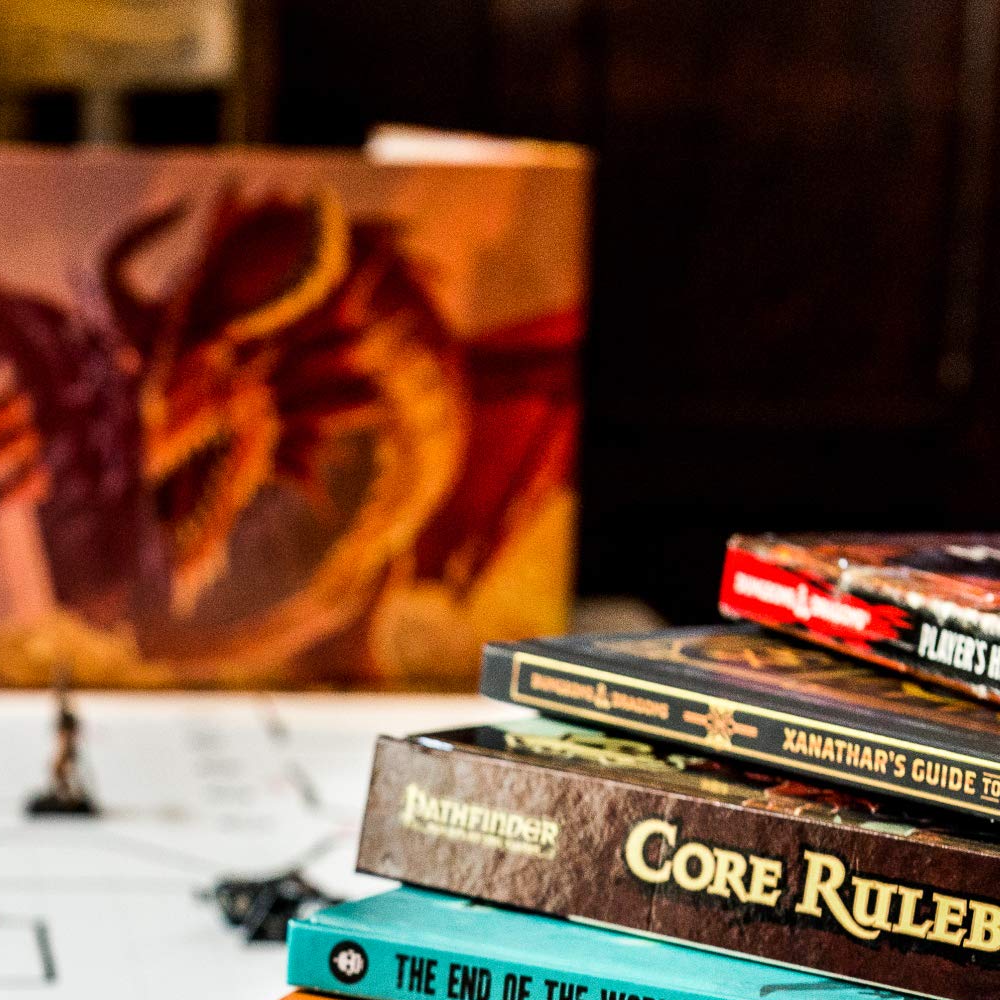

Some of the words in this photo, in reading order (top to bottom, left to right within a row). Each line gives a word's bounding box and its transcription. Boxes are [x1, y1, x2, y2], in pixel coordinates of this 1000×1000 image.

[782, 727, 907, 778] XANATHAR'S
[911, 758, 977, 796] GUIDE
[401, 783, 560, 853] PATHFINDER
[625, 819, 782, 907] CORE
[795, 850, 1000, 953] RULEB
[395, 954, 438, 996] THE
